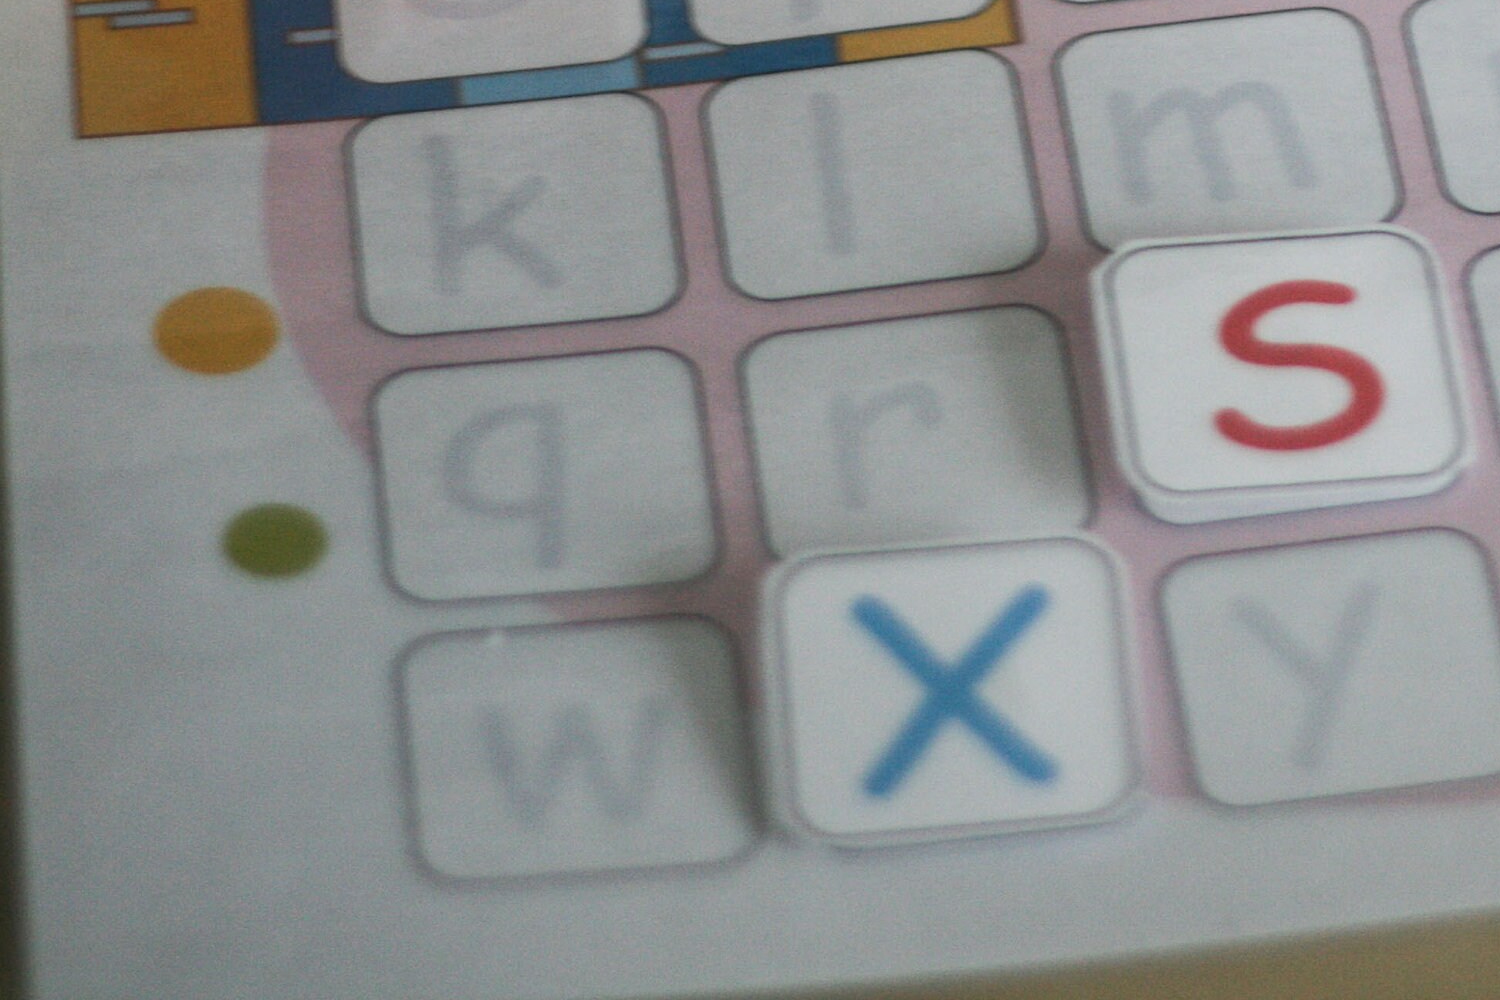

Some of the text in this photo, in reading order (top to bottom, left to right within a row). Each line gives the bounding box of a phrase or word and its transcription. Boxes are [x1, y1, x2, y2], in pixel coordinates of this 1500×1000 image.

[424, 134, 567, 295] k
[1106, 81, 1320, 201] m
[444, 404, 566, 569] q
[828, 383, 941, 508] r
[1211, 279, 1386, 453] S
[850, 582, 1059, 799] X
